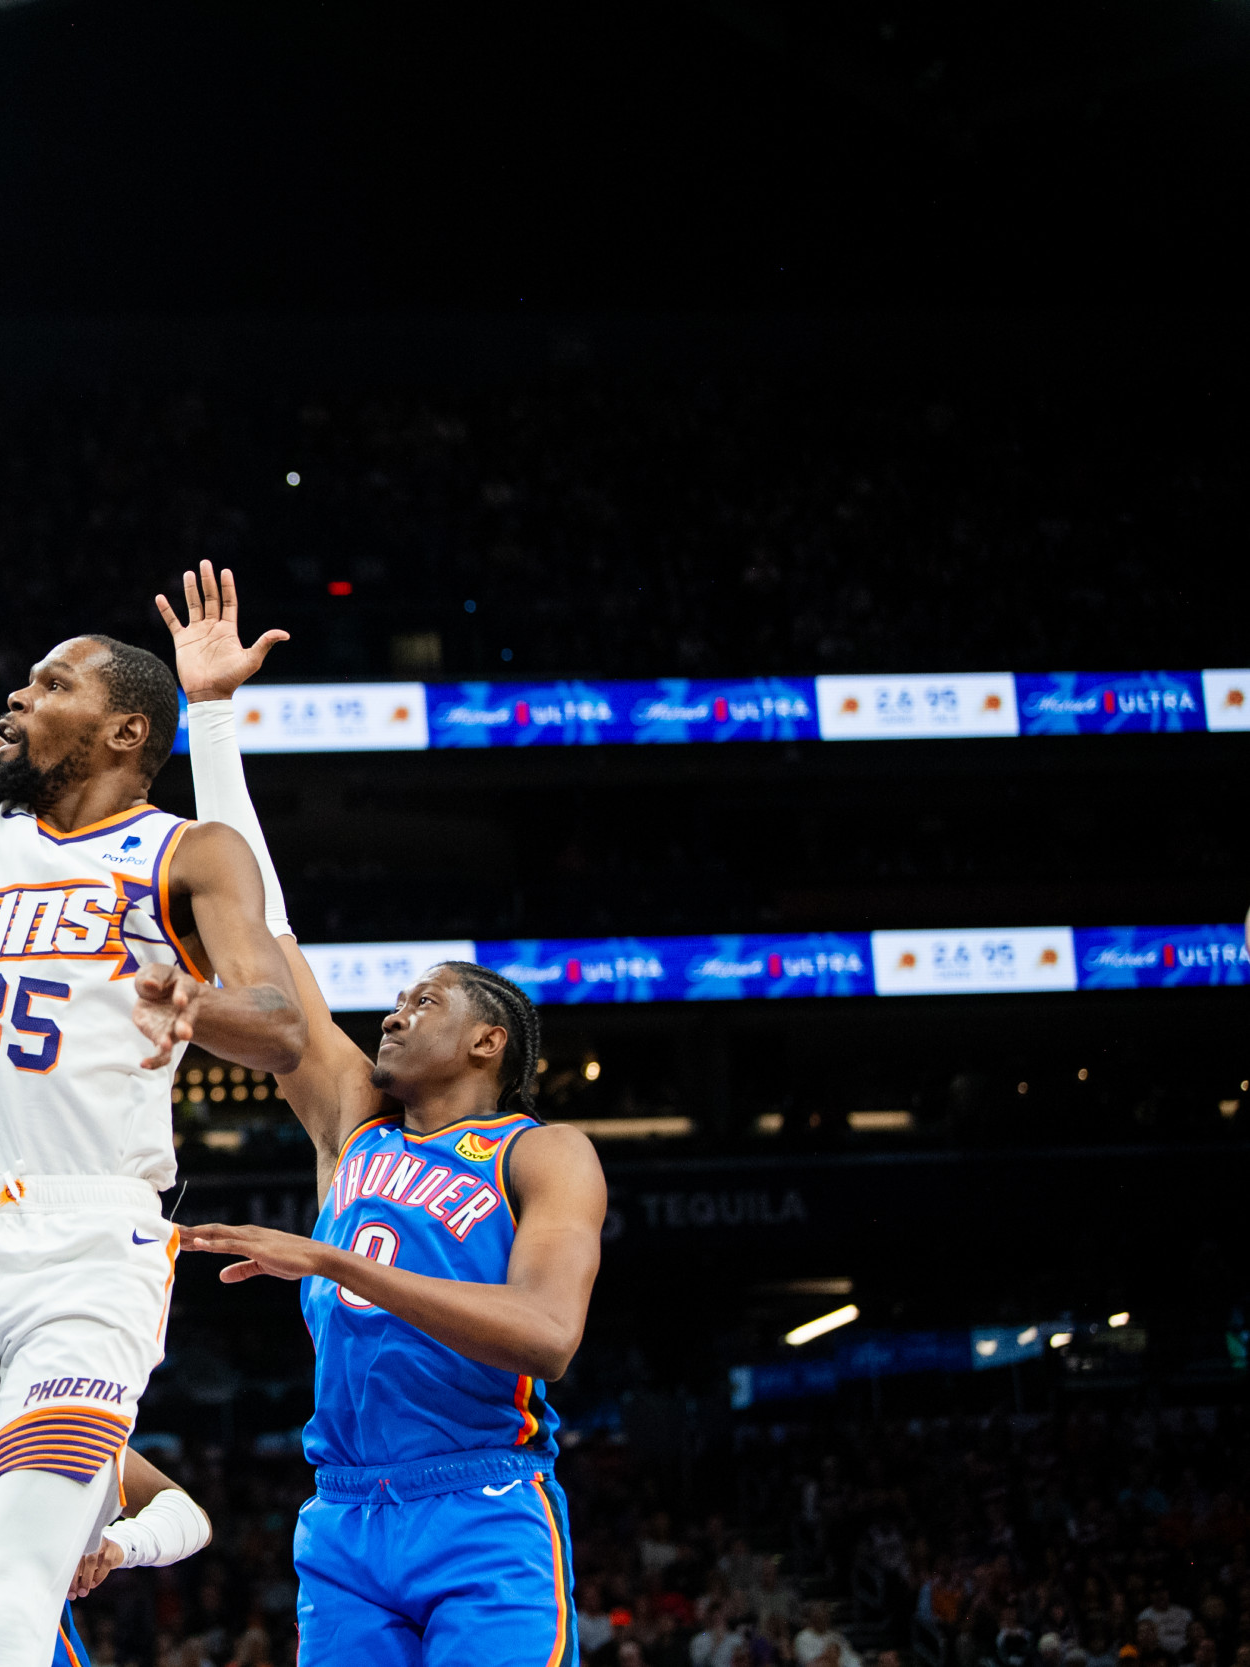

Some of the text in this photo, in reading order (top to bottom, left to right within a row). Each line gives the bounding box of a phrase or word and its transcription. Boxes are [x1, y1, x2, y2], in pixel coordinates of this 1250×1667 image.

[1118, 689, 1196, 714] ULTRA
[102, 853, 148, 866] PayPal
[1177, 943, 1249, 968] ULTRA
[333, 1151, 501, 1242] THUNDER
[640, 1189, 808, 1227] TEQUILA
[23, 1377, 127, 1407] PHOENIX
